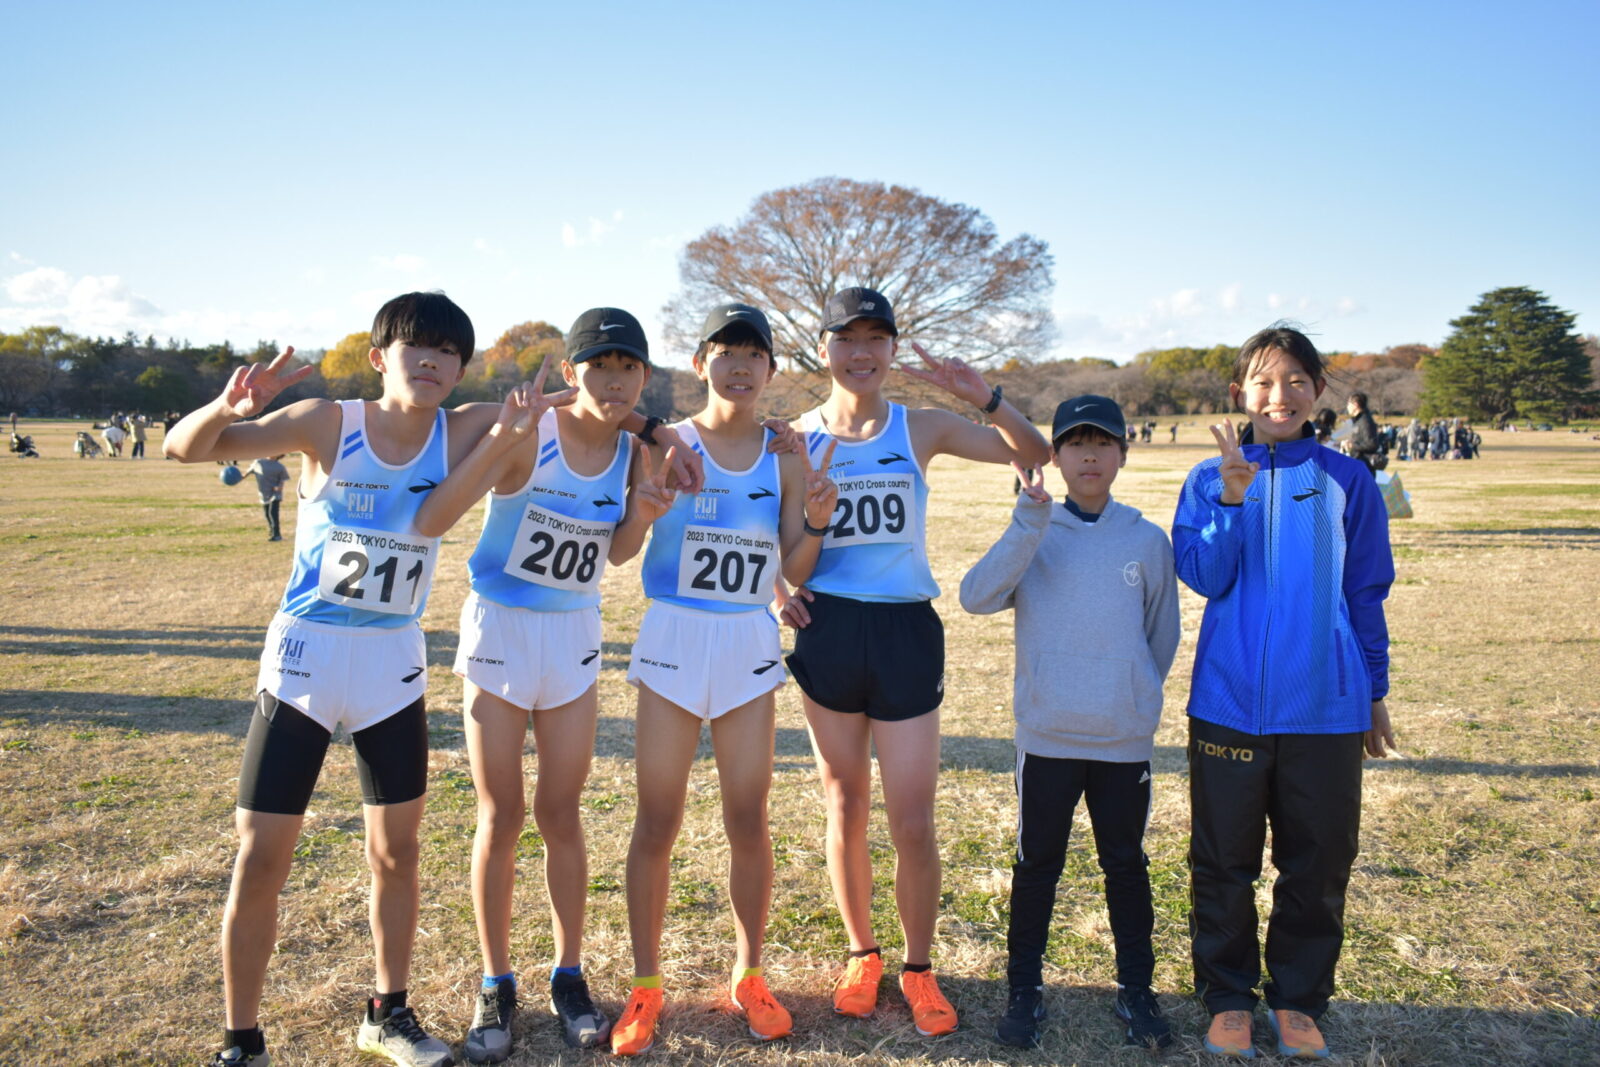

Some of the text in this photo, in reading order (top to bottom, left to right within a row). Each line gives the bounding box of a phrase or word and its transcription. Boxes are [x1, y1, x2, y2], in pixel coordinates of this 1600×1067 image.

[834, 460, 855, 468] TOKYO
[557, 490, 577, 499] TOKYO
[839, 480, 910, 492] TOKYO Cross country
[347, 492, 374, 513] FIJI
[694, 496, 717, 514] FIJI
[347, 512, 374, 520] WATER
[527, 510, 610, 538] 2023 TOKYO Cross country
[833, 493, 905, 539] 209
[331, 531, 429, 555] 2023 TOKYO Cross country
[686, 531, 774, 551] 2023 TOKYO Cross country
[520, 531, 599, 583] 208
[333, 550, 423, 605] 211
[691, 548, 767, 594] 207
[277, 637, 305, 659] FIJI
[485, 658, 505, 666] TOKYO
[660, 662, 679, 670] TOKYO
[287, 669, 311, 678] TOKYO
[1197, 739, 1254, 762] TOKYO
